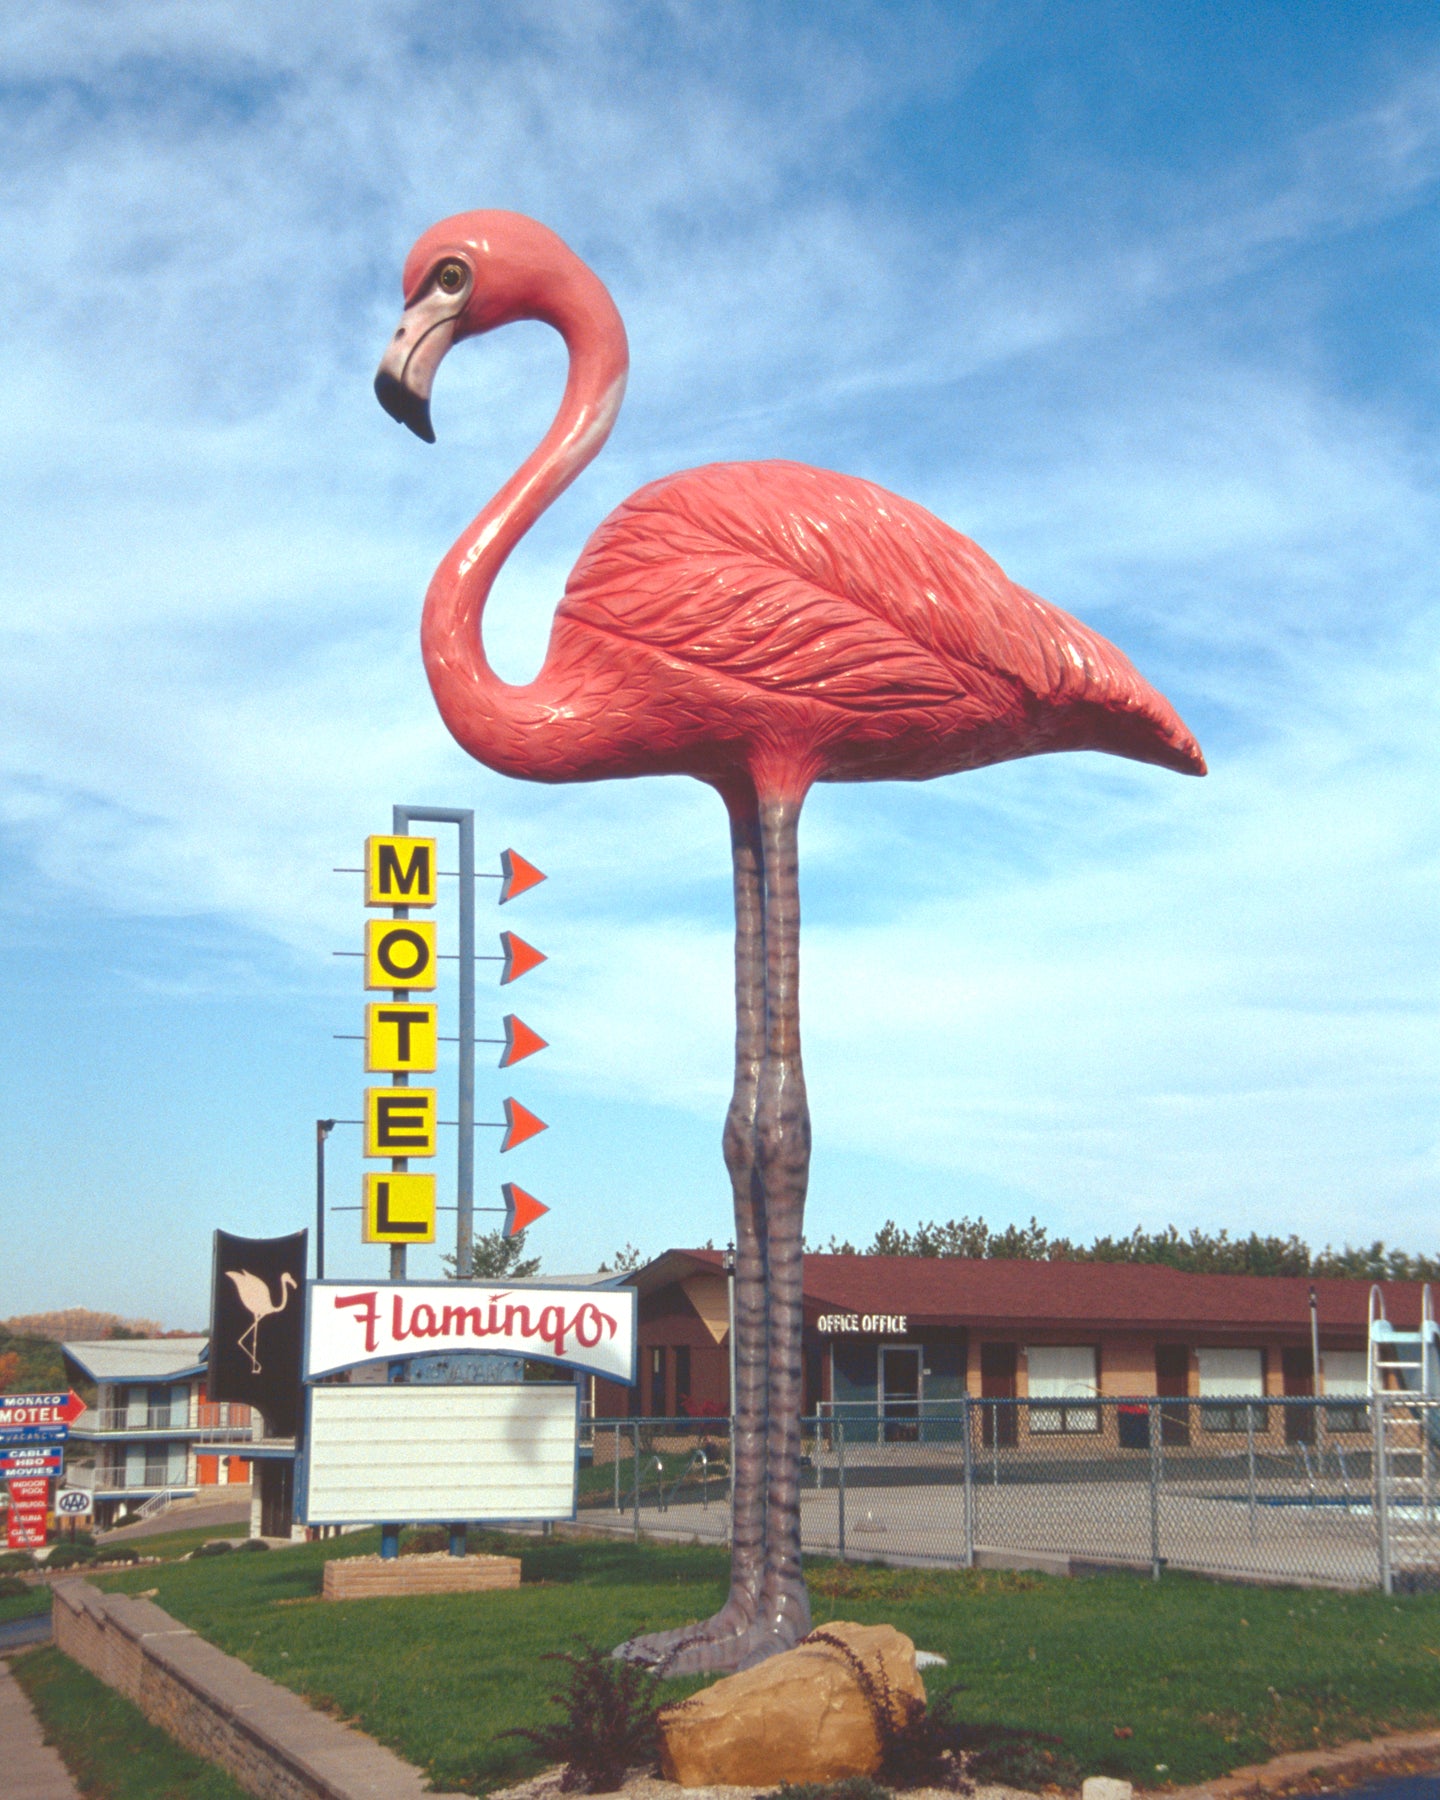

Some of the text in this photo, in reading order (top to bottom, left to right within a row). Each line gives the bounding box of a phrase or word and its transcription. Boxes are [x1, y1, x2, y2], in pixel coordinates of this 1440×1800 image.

[377, 844, 430, 1234] MOTEL
[334, 1291, 618, 1356] Flamingo
[817, 1314, 907, 1333] OFFICE OFFICE
[4, 1396, 61, 1406] MONACO
[0, 1407, 64, 1423] MOTEL
[9, 1449, 51, 1458] CABLE
[15, 1458, 45, 1467] HBO
[5, 1467, 54, 1476] MOVIES
[63, 1494, 88, 1511] AAA
